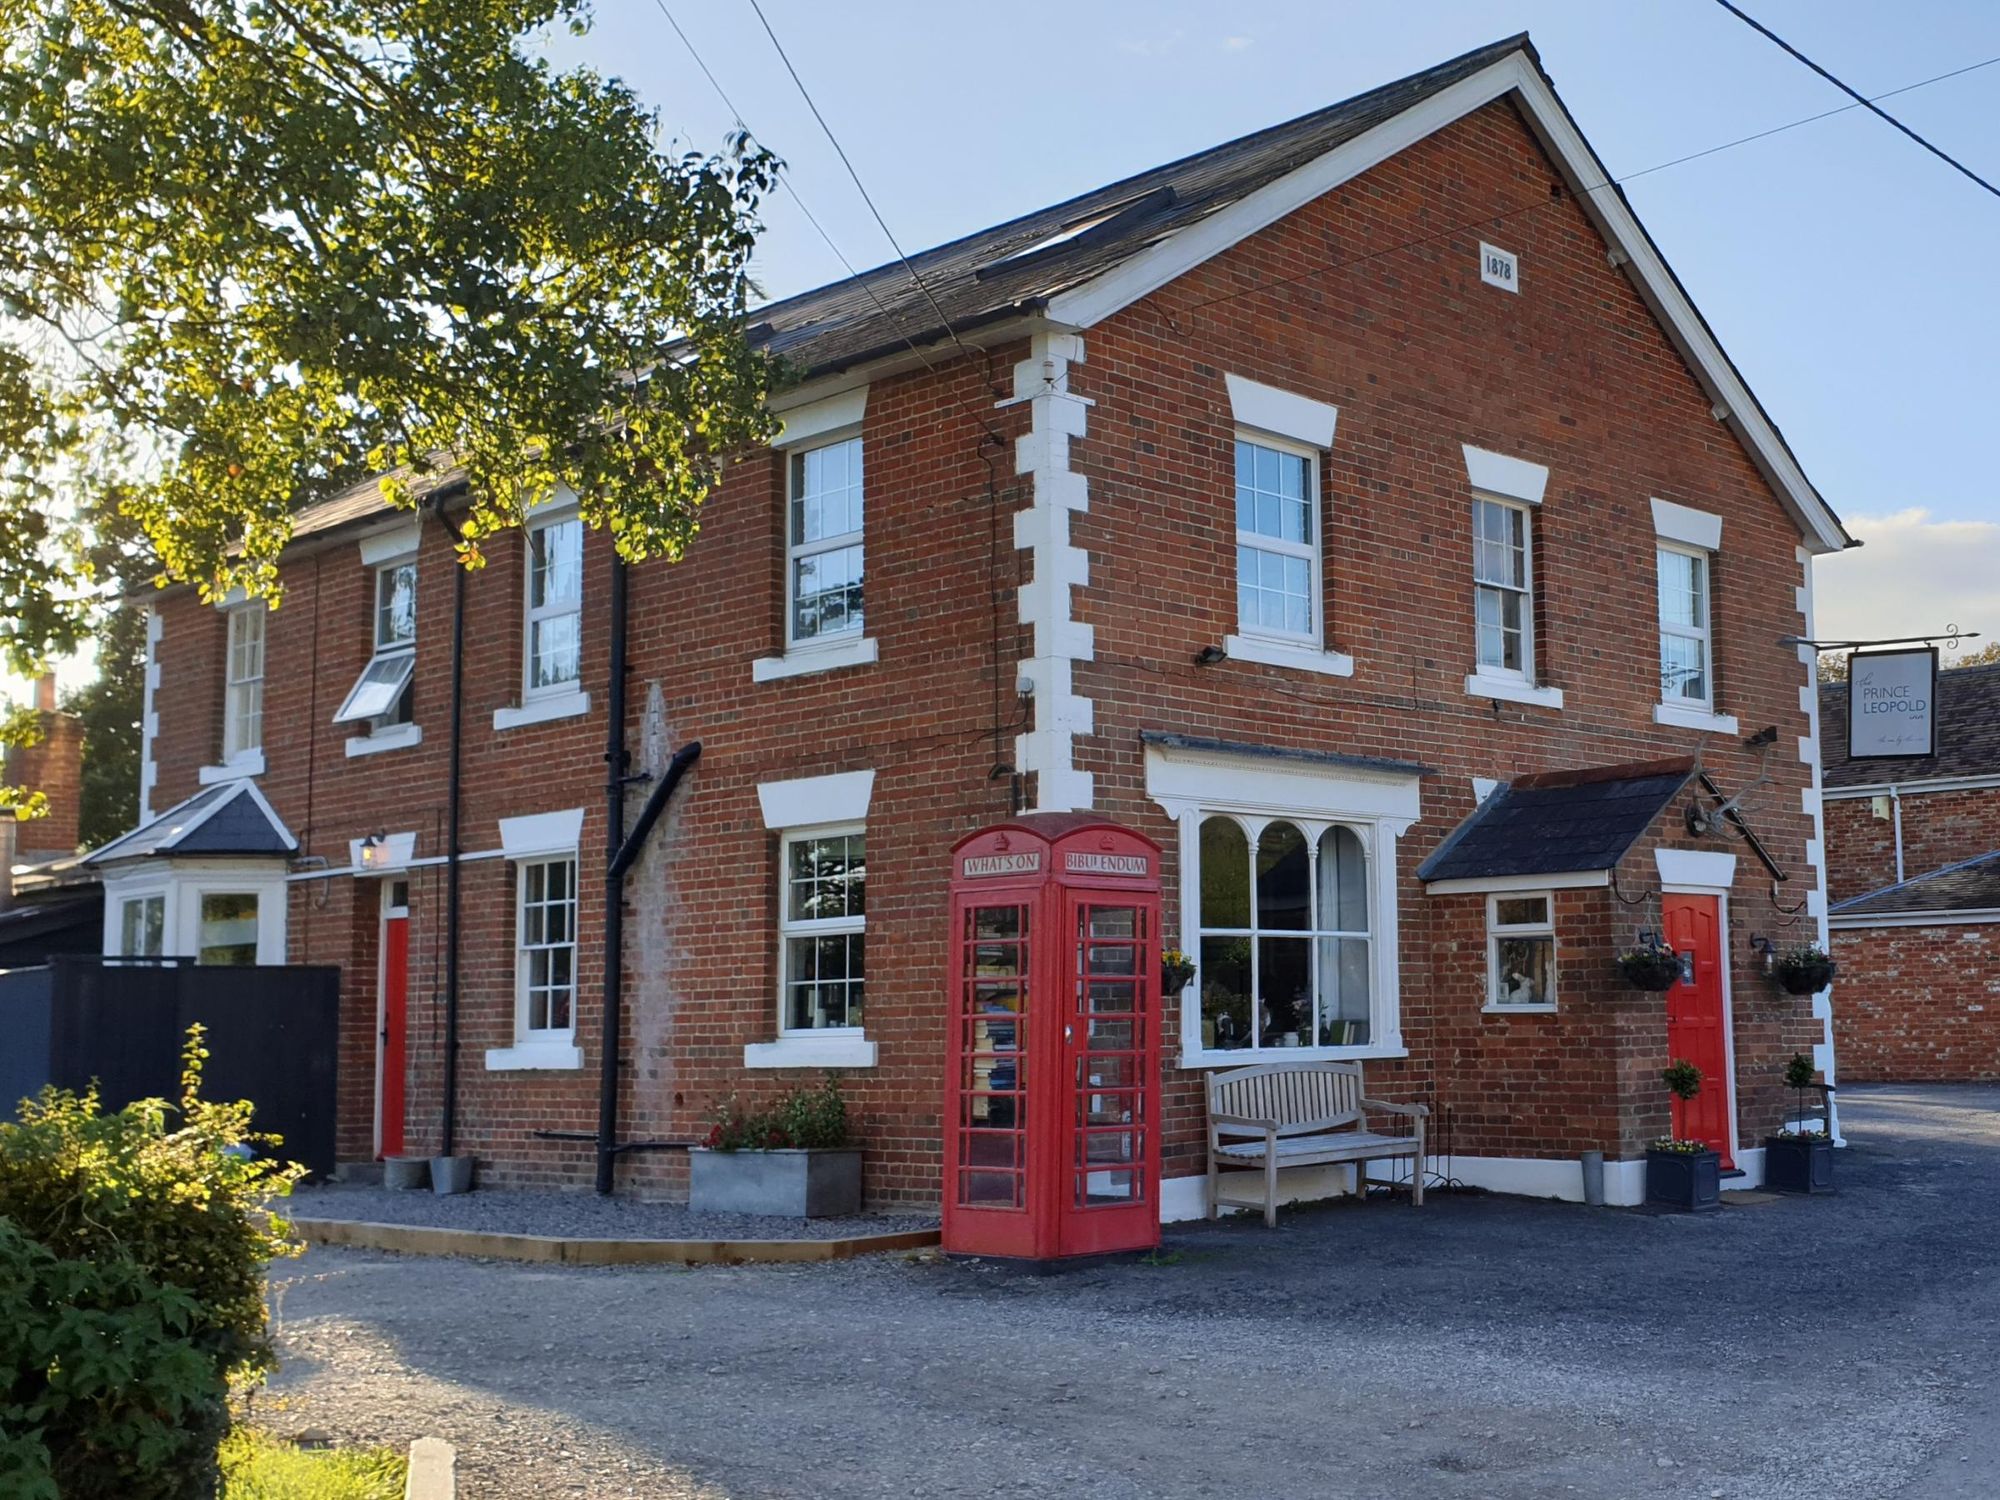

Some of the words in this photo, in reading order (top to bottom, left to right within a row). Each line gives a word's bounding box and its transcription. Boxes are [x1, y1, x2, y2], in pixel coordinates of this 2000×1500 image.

[1486, 255, 1511, 280] 1878
[1863, 685, 1911, 699] PRINCE
[1863, 699, 1927, 714] LEOPOLD
[967, 855, 1013, 873] WHAT'S
[1016, 854, 1036, 870] ON
